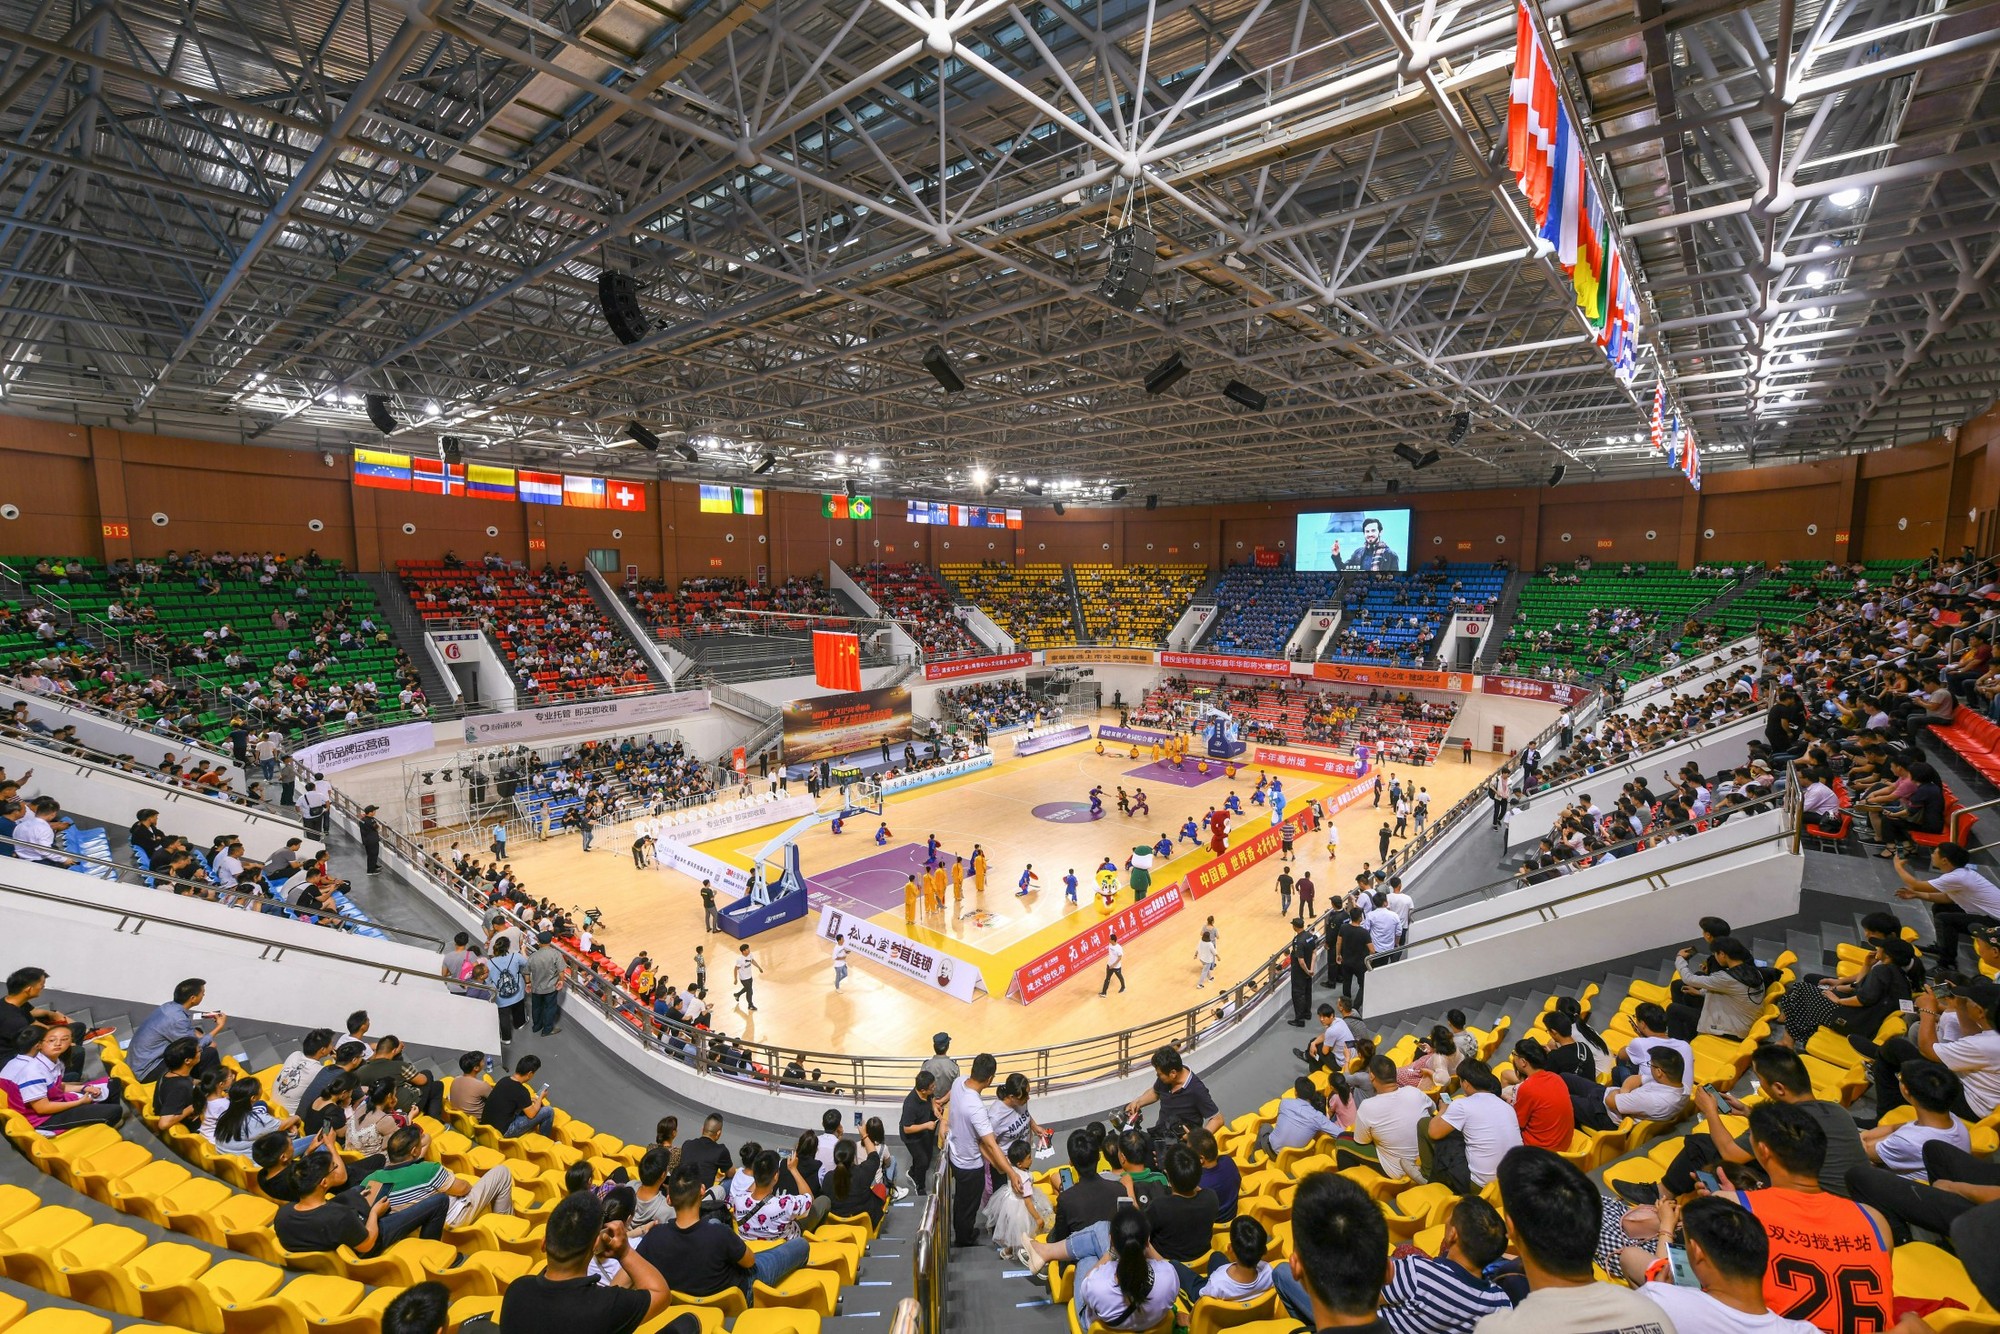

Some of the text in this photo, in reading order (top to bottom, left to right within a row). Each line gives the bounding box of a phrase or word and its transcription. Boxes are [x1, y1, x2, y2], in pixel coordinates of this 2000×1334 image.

[103, 525, 129, 536] B13
[529, 540, 545, 549] B14
[1467, 624, 1478, 633] 10
[535, 710, 571, 721] 专业托管
[575, 704, 618, 717] 即买即收租
[326, 759, 341, 768] brand
[342, 755, 363, 765] service
[363, 748, 390, 761] provider
[1258, 752, 1358, 776] 千年亳州城 一座金桂
[1200, 862, 1229, 888] 中国酿
[1230, 845, 1256, 872] 世界香
[1767, 1224, 1872, 1253] 双沟搅拌站
[1771, 1253, 1887, 1334] 26
